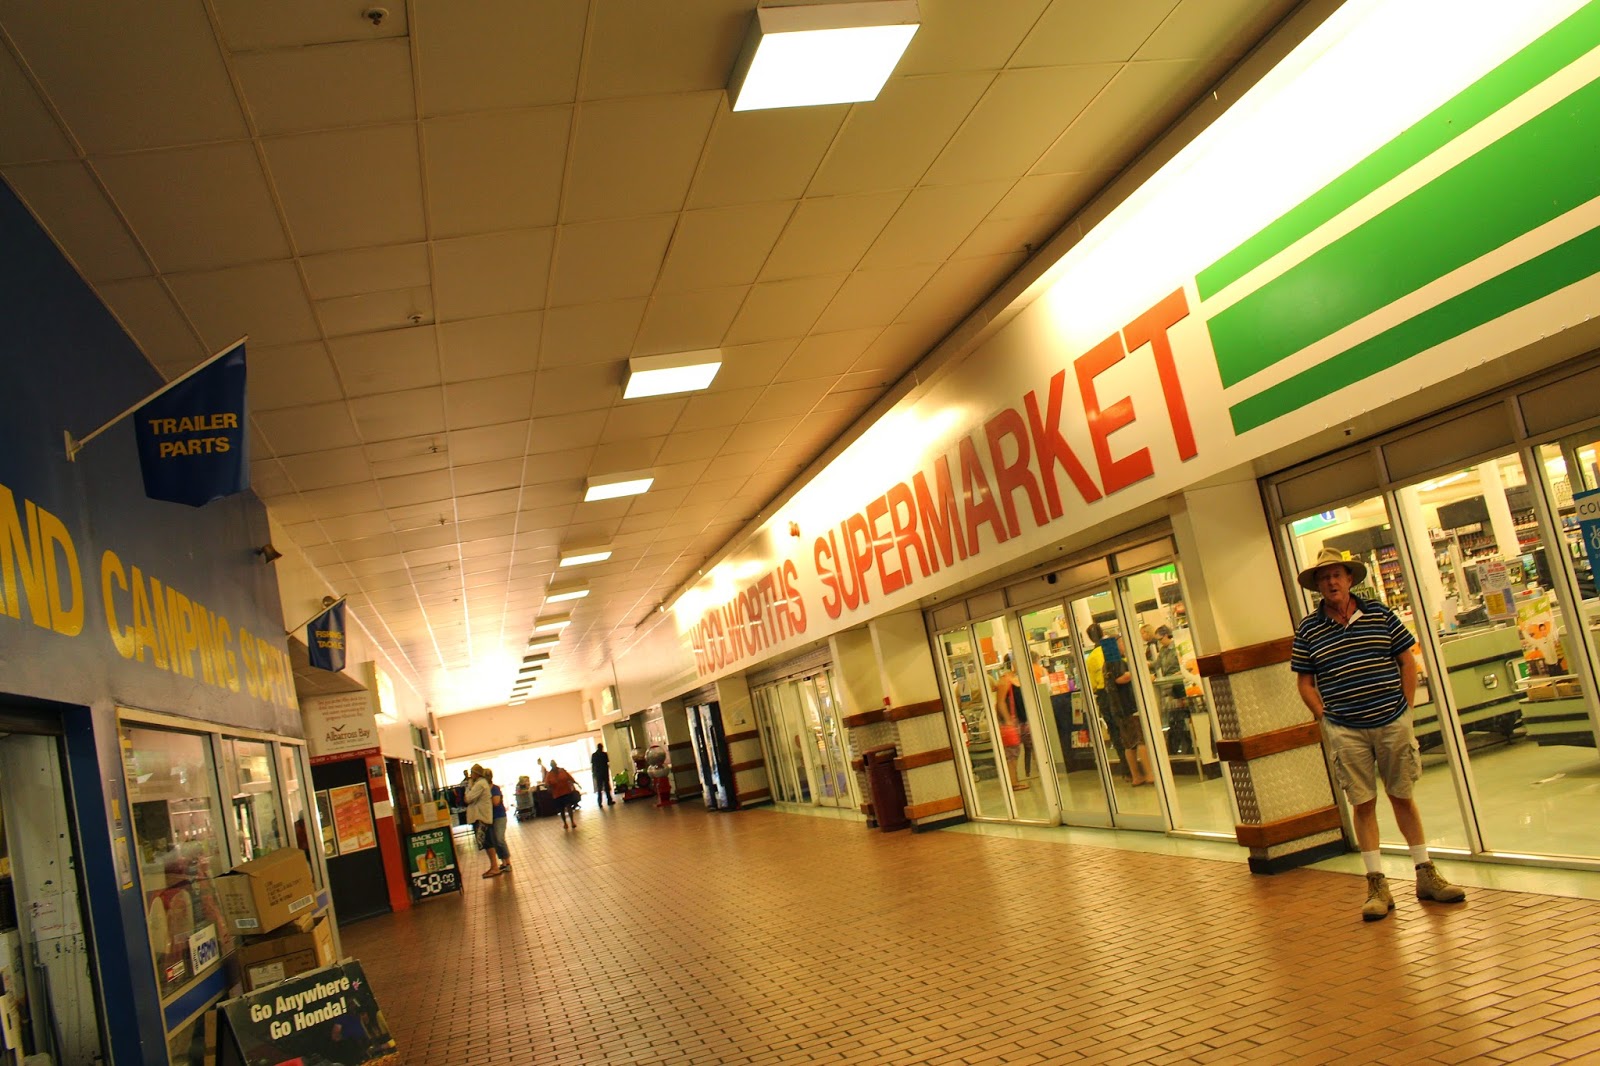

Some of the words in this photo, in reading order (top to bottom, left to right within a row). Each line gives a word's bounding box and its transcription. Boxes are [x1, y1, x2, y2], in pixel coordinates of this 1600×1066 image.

[148, 412, 239, 435] TRAILER
[160, 436, 231, 458] PARTS
[689, 559, 807, 677] WOOLWORTHS
[813, 286, 1199, 620] SUPERMARKET
[0, 483, 85, 637] ND
[101, 549, 240, 693] CAMPING
[325, 730, 358, 742] Albatross
[358, 727, 371, 738] Bay
[411, 832, 431, 843] BACK
[432, 831, 444, 839] TO
[426, 836, 444, 846] BEST
[250, 1004, 273, 1023] Go
[275, 976, 351, 1016] Anywhere
[269, 1020, 292, 1040] Go
[293, 996, 348, 1031] Honda!
